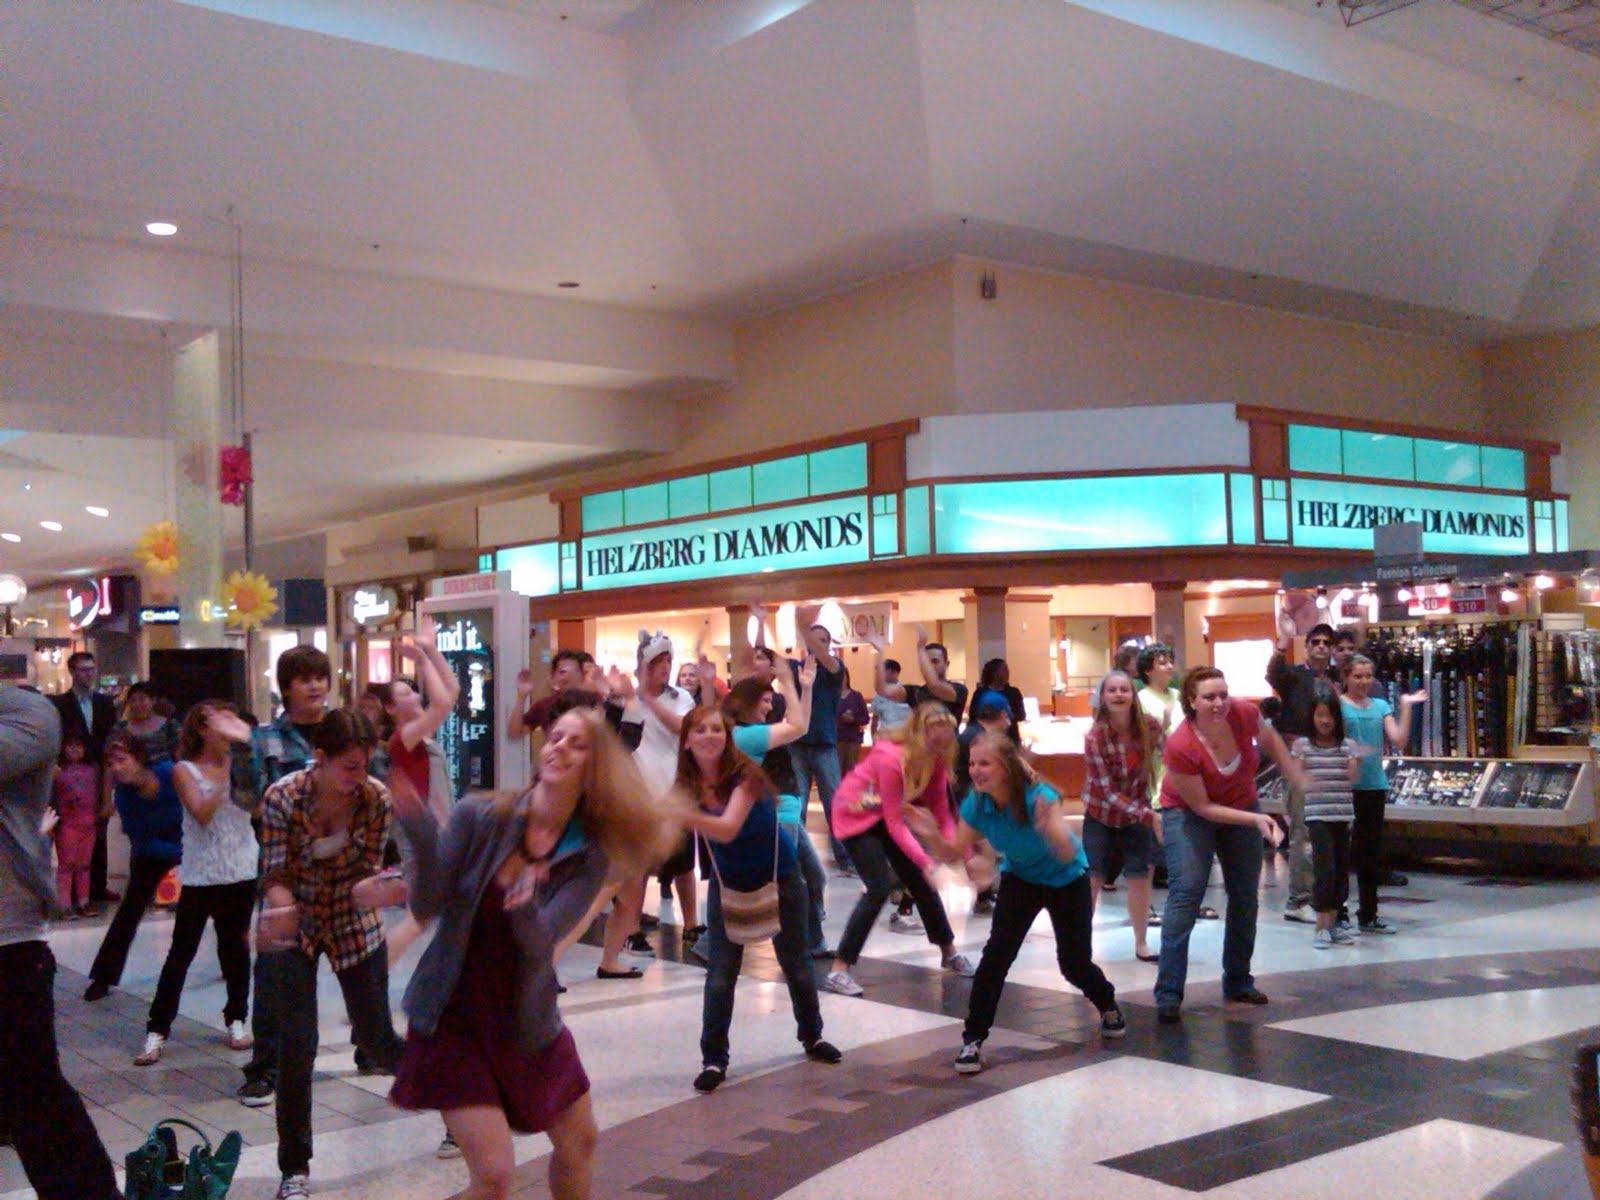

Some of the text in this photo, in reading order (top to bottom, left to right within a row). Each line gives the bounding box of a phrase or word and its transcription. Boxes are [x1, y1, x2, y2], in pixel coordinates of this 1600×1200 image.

[1297, 499, 1525, 538] HELZBERG DIAMONDS
[587, 512, 863, 577] HELZBERG DIAMONDS
[1377, 567, 1410, 580] Fashion
[1457, 601, 1478, 612] $10
[434, 620, 463, 652] ind
[841, 613, 885, 638] MOM
